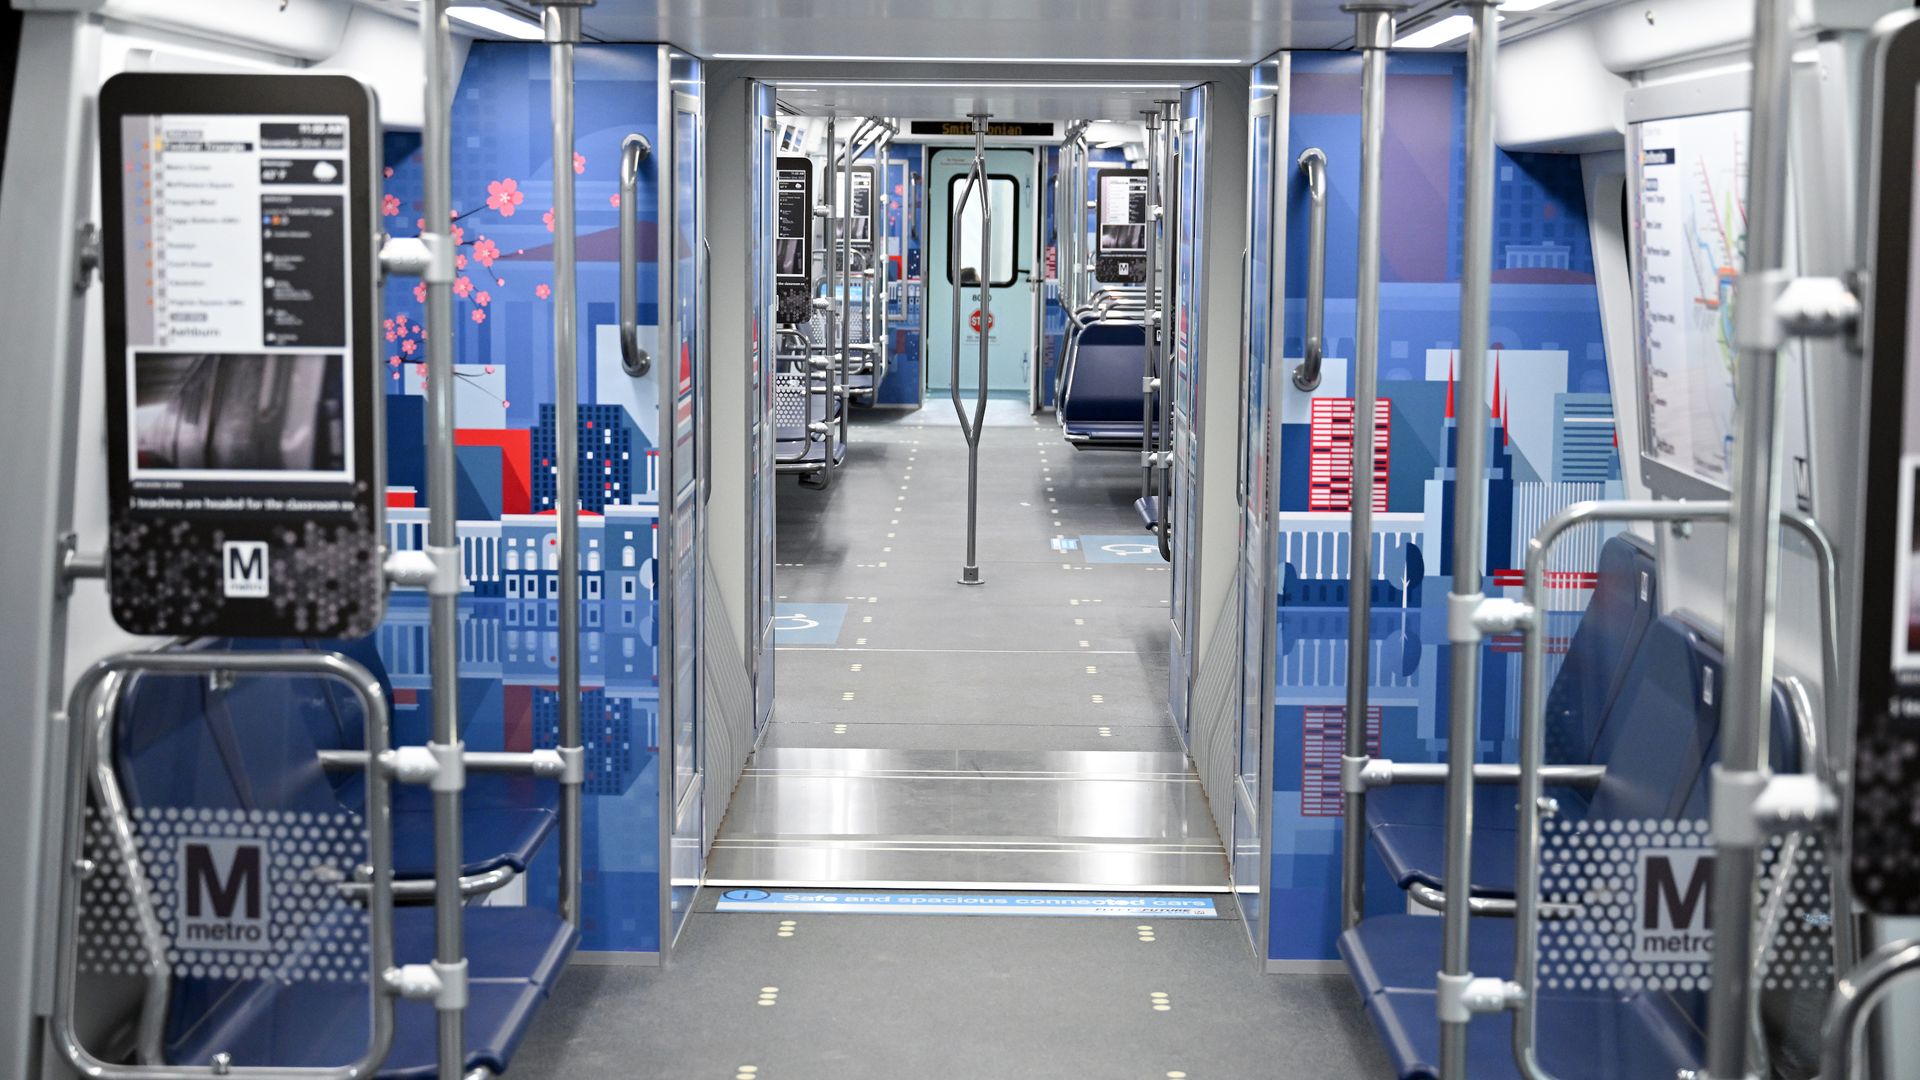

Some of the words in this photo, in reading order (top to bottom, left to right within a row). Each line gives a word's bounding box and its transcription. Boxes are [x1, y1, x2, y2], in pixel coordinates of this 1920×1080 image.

[942, 122, 1023, 135] Smitonian
[972, 294, 992, 302] 800
[971, 316, 992, 326] STP
[230, 548, 263, 580] M
[230, 582, 263, 591] metro
[186, 844, 260, 918] M
[783, 894, 837, 903] Safe
[844, 895, 891, 904] and
[898, 897, 1008, 905] spacious
[1015, 898, 1145, 906] connected
[1153, 899, 1206, 907] cars
[187, 921, 261, 940] metro
